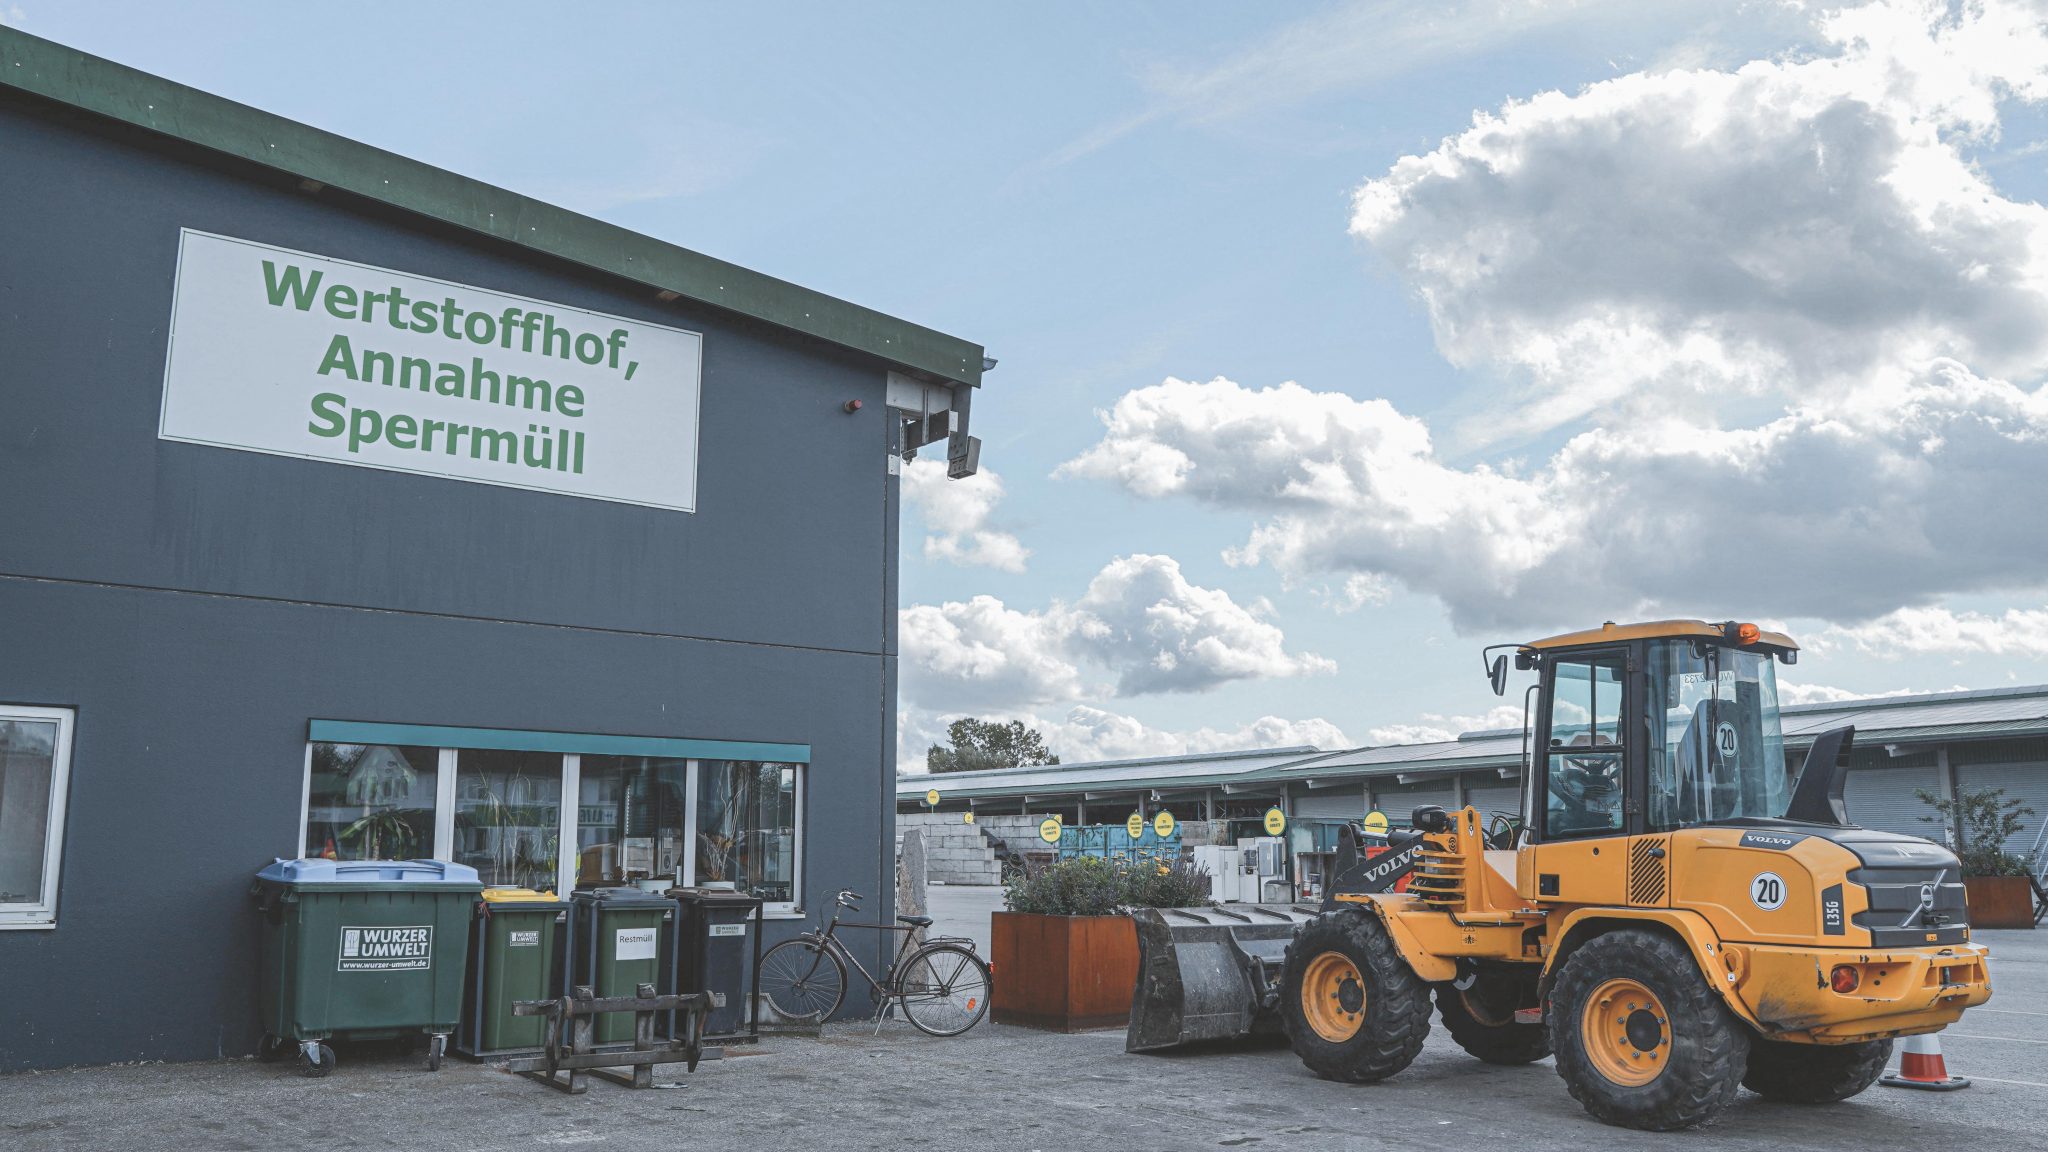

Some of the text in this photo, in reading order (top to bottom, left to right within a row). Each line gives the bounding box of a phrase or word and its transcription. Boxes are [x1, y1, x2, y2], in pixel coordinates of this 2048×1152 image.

[261, 260, 640, 381] Wertstoffhof,
[316, 334, 586, 418] Annahme
[307, 392, 586, 474] Sperrmüll
[1720, 728, 1735, 751] 20
[1747, 835, 1792, 845] VOLVO
[1363, 844, 1424, 882] VOLVO
[1757, 878, 1780, 904] 20
[1825, 901, 1840, 926] L35G
[363, 929, 427, 943] WURZER
[619, 934, 653, 943] Restmüll
[361, 943, 428, 957] UMWELT
[343, 960, 427, 969] www.wurzer-umwelt.de
